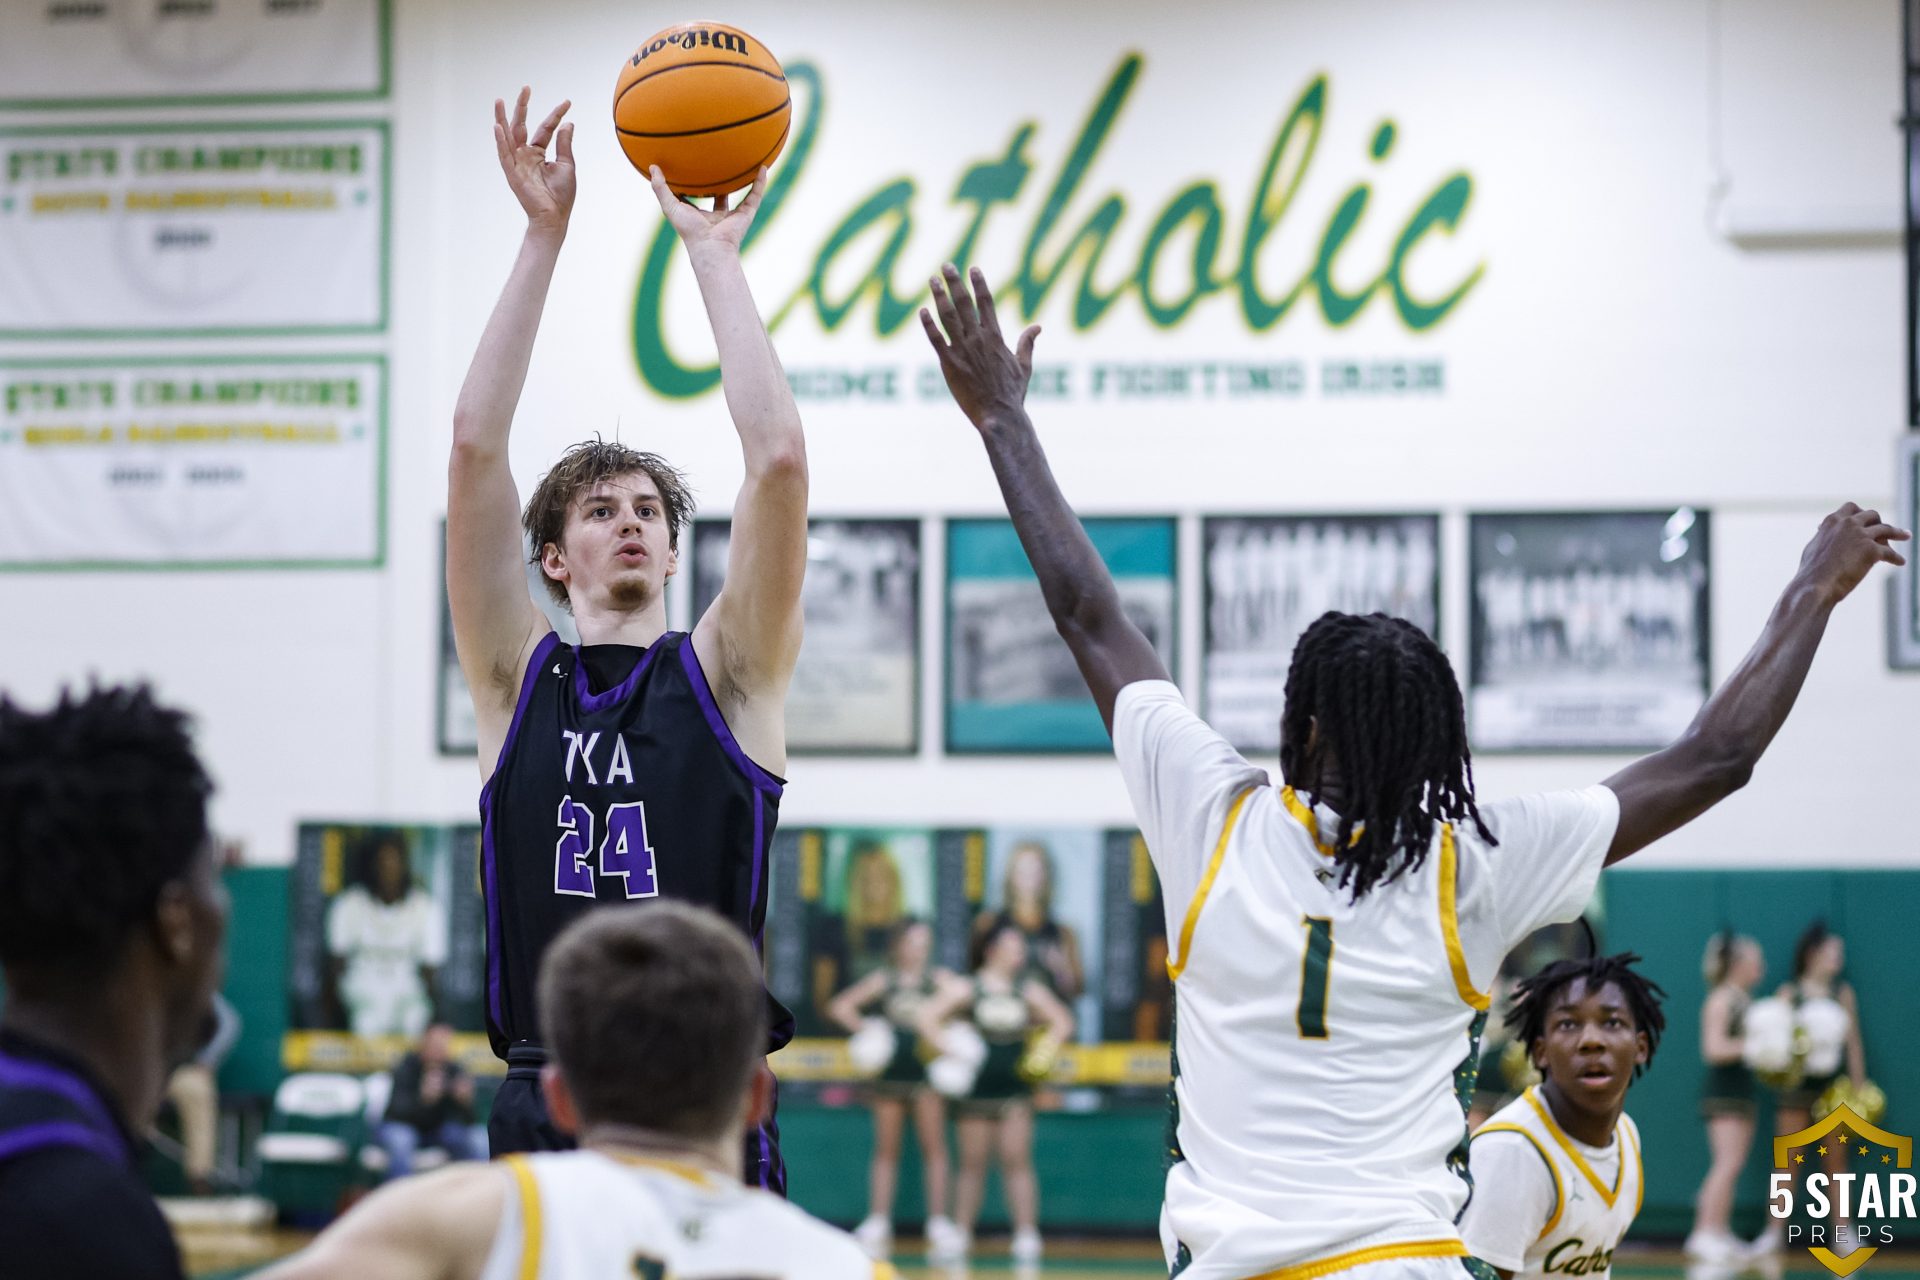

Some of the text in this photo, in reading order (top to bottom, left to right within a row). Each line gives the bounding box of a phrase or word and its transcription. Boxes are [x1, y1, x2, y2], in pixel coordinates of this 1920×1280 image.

[630, 29, 749, 67] Wilson
[629, 50, 1488, 400] Catholic
[554, 794, 659, 900] 24
[1297, 914, 1334, 1042] 1
